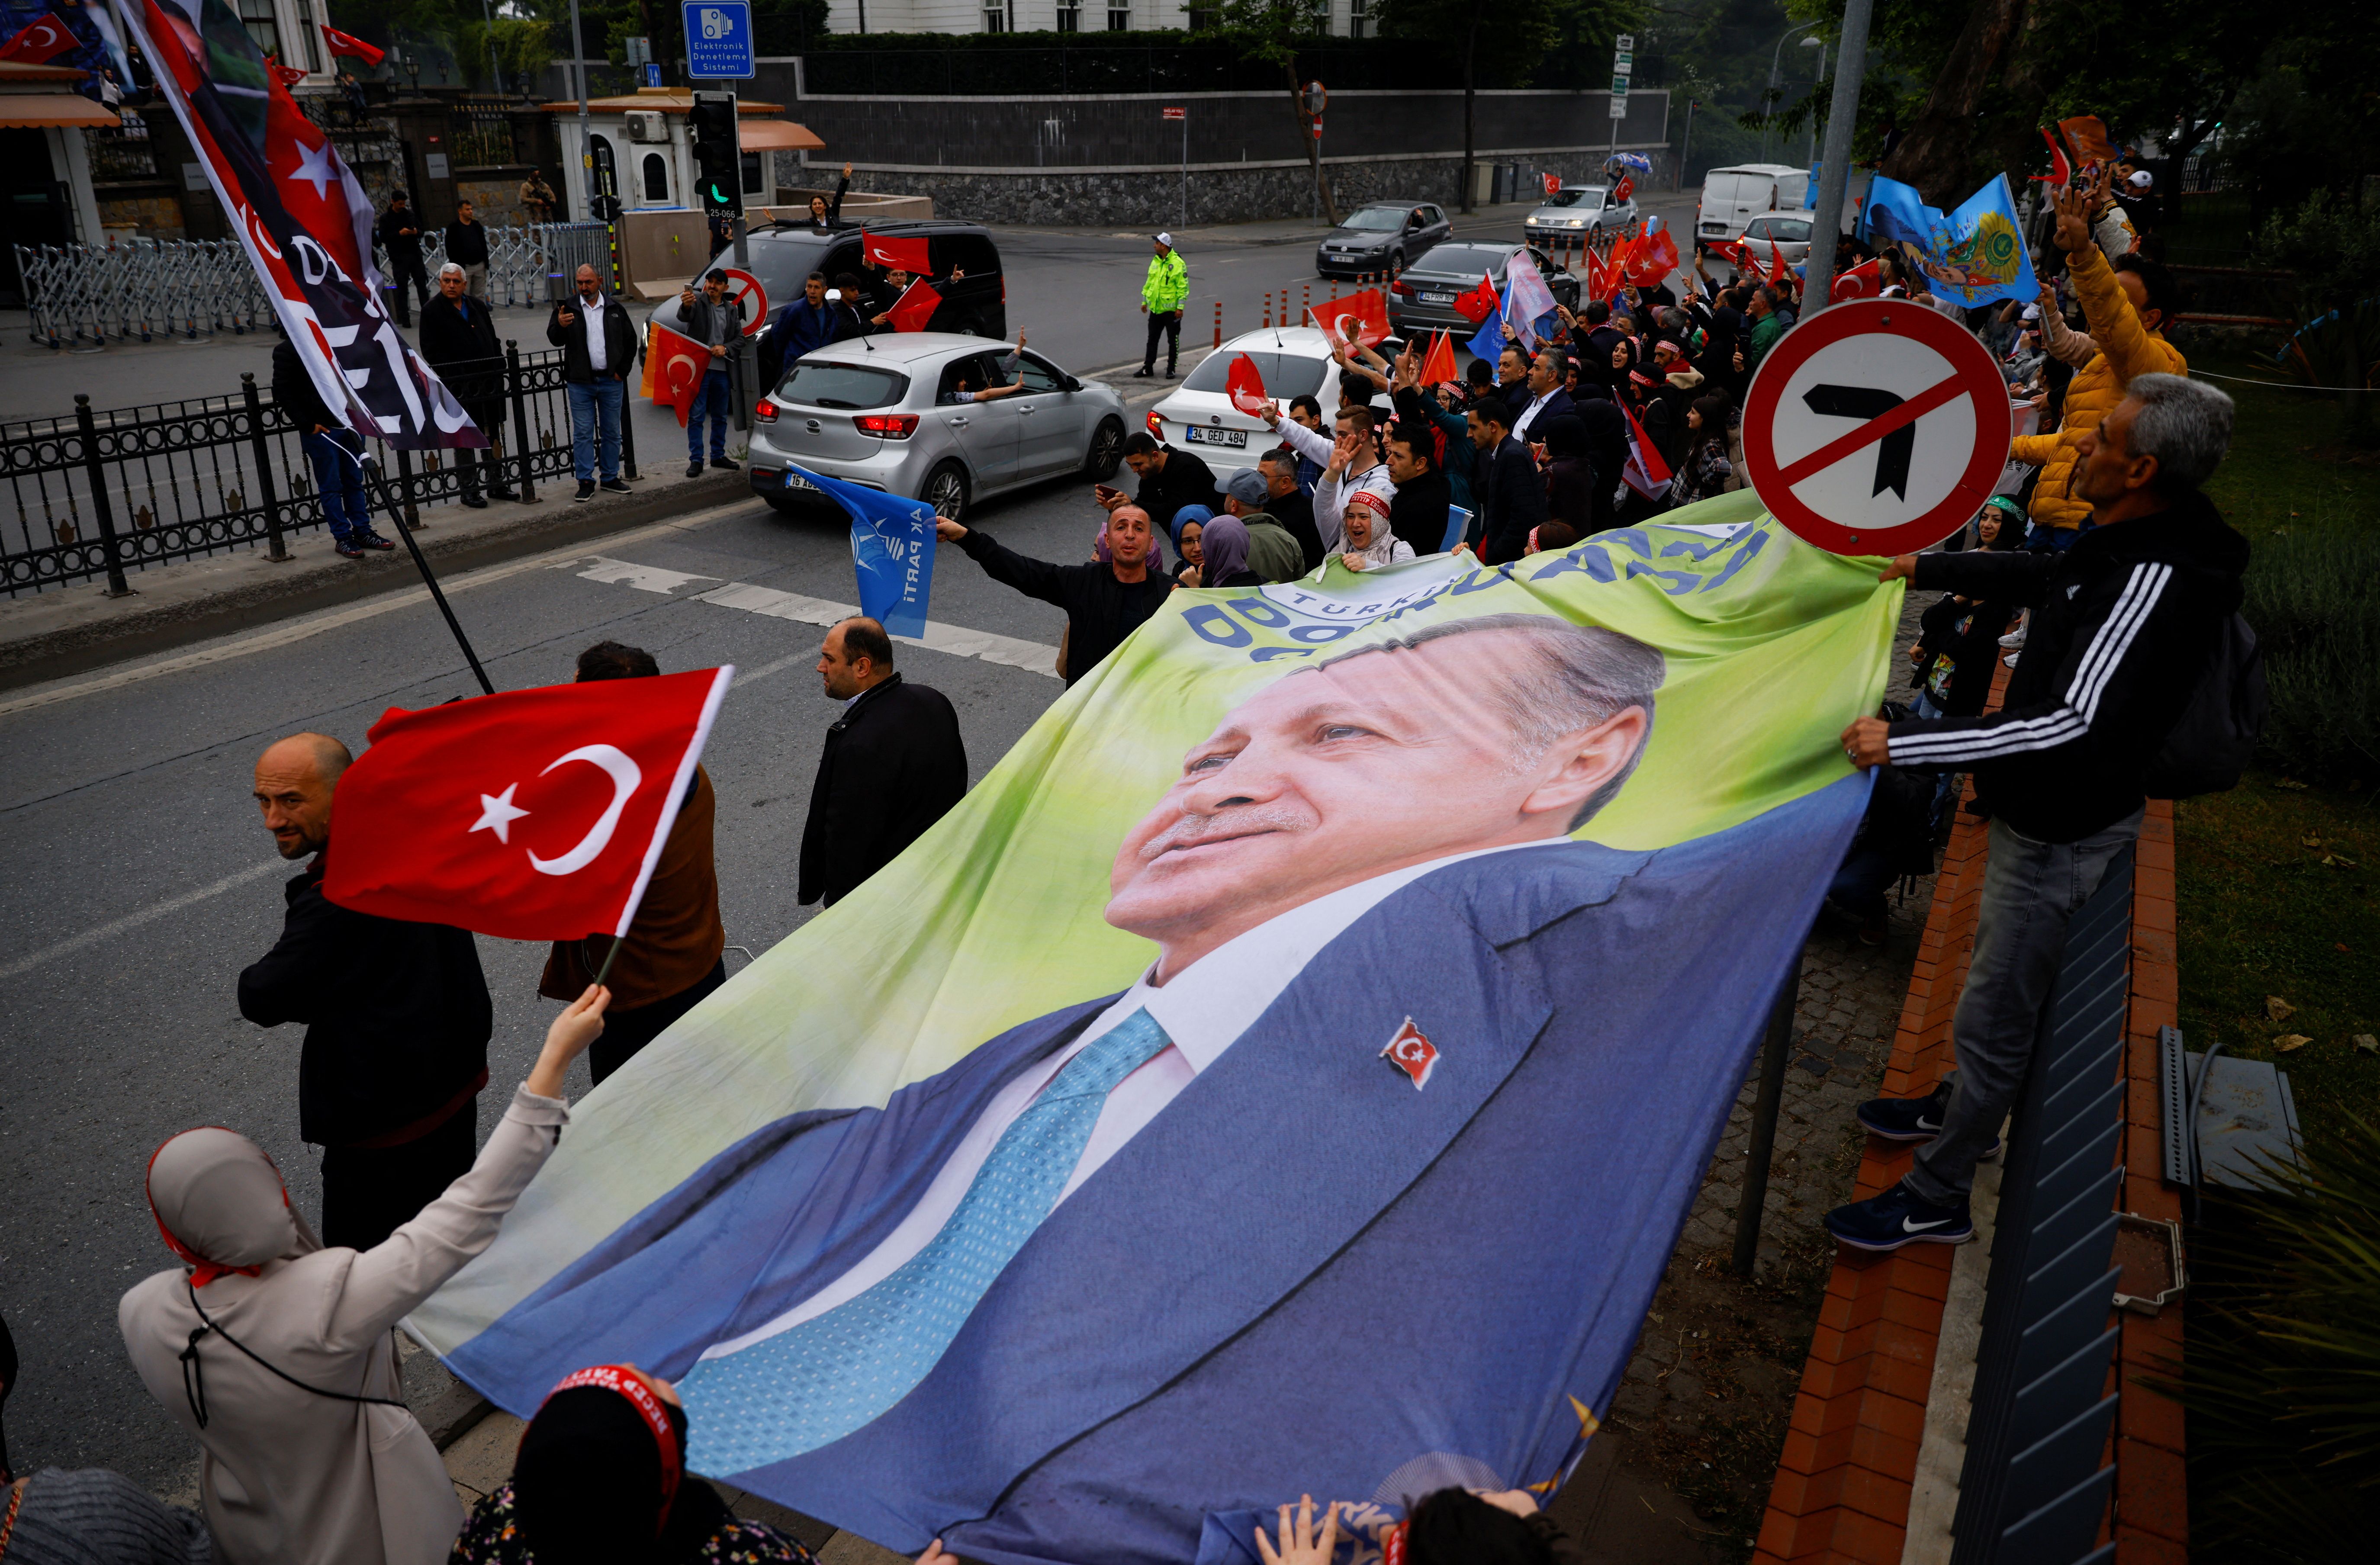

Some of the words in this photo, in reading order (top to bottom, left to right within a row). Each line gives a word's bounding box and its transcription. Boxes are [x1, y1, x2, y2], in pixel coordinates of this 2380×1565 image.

[710, 209, 735, 219] 25-066
[1193, 428, 1203, 439] 34
[1208, 430, 1224, 441] GED
[1229, 432, 1244, 444] 484
[792, 475, 801, 485] 16
[622, 1379, 668, 1435] RECEP
